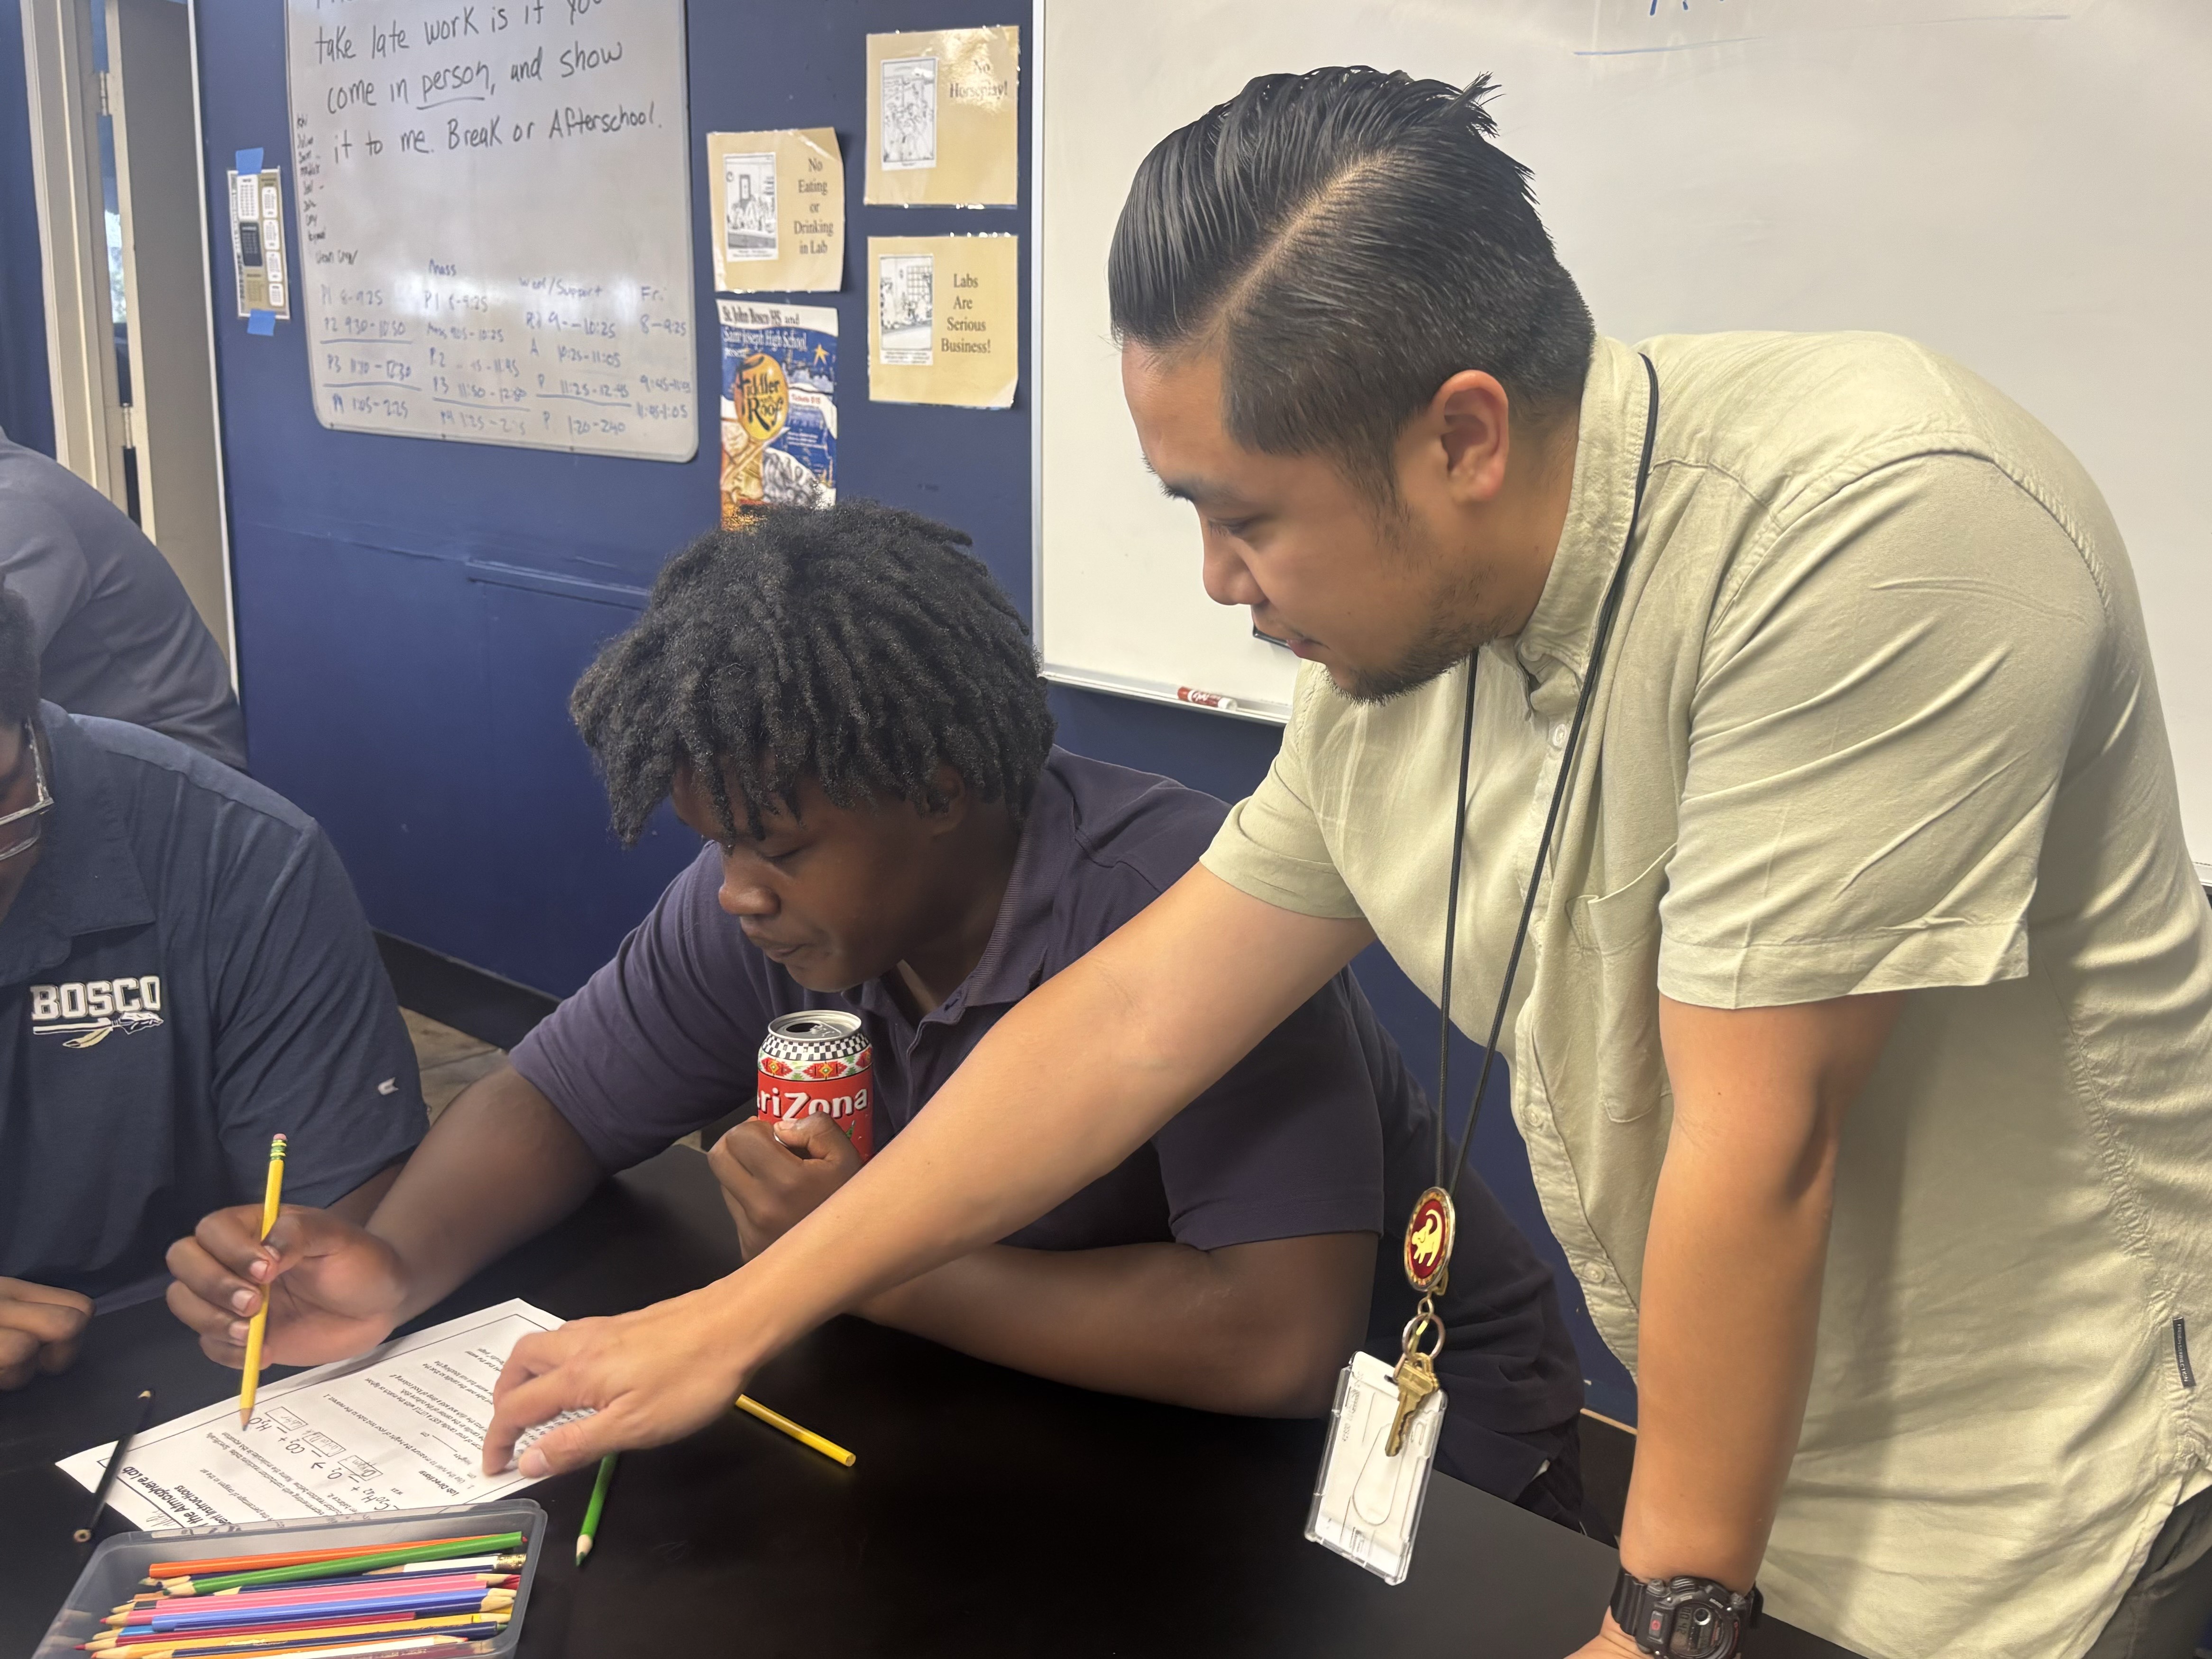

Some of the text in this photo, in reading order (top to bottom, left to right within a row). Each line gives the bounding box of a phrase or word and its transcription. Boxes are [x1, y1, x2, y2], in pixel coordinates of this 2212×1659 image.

[315, 26, 356, 64] take
[371, 20, 410, 59] late
[424, 7, 479, 45] work
[492, 7, 508, 32] is
[567, 0, 602, 25] yo
[328, 41, 623, 114] come in person, and show
[334, 129, 353, 164] it
[365, 131, 383, 156] to
[448, 115, 503, 150] Break
[513, 122, 535, 142] or
[549, 101, 662, 139] Afterschool.
[808, 157, 823, 172] No
[798, 178, 828, 196] Eating
[809, 202, 820, 213] or
[793, 219, 834, 237] Drinking
[799, 239, 828, 254] in Lab
[954, 273, 979, 288] Labs
[953, 295, 973, 310] Are
[733, 306, 749, 324] John
[749, 307, 769, 325] Bosco
[785, 313, 800, 325] and
[947, 316, 987, 331] Serious
[743, 328, 765, 352] Joseph
[765, 329, 783, 352] High
[783, 330, 808, 353] School
[941, 337, 991, 354] Business!
[748, 396, 784, 431] Roof
[30, 975, 160, 1021] BOSCO
[757, 1088, 868, 1122] riZona
[389, 1434, 405, 1444] height
[410, 1448, 431, 1461] measure
[122, 1467, 143, 1479] Lab
[138, 1477, 189, 1512] Atmosphere
[174, 1485, 216, 1515] Instructions
[446, 1488, 459, 1496] Lab
[183, 1512, 203, 1524] the
